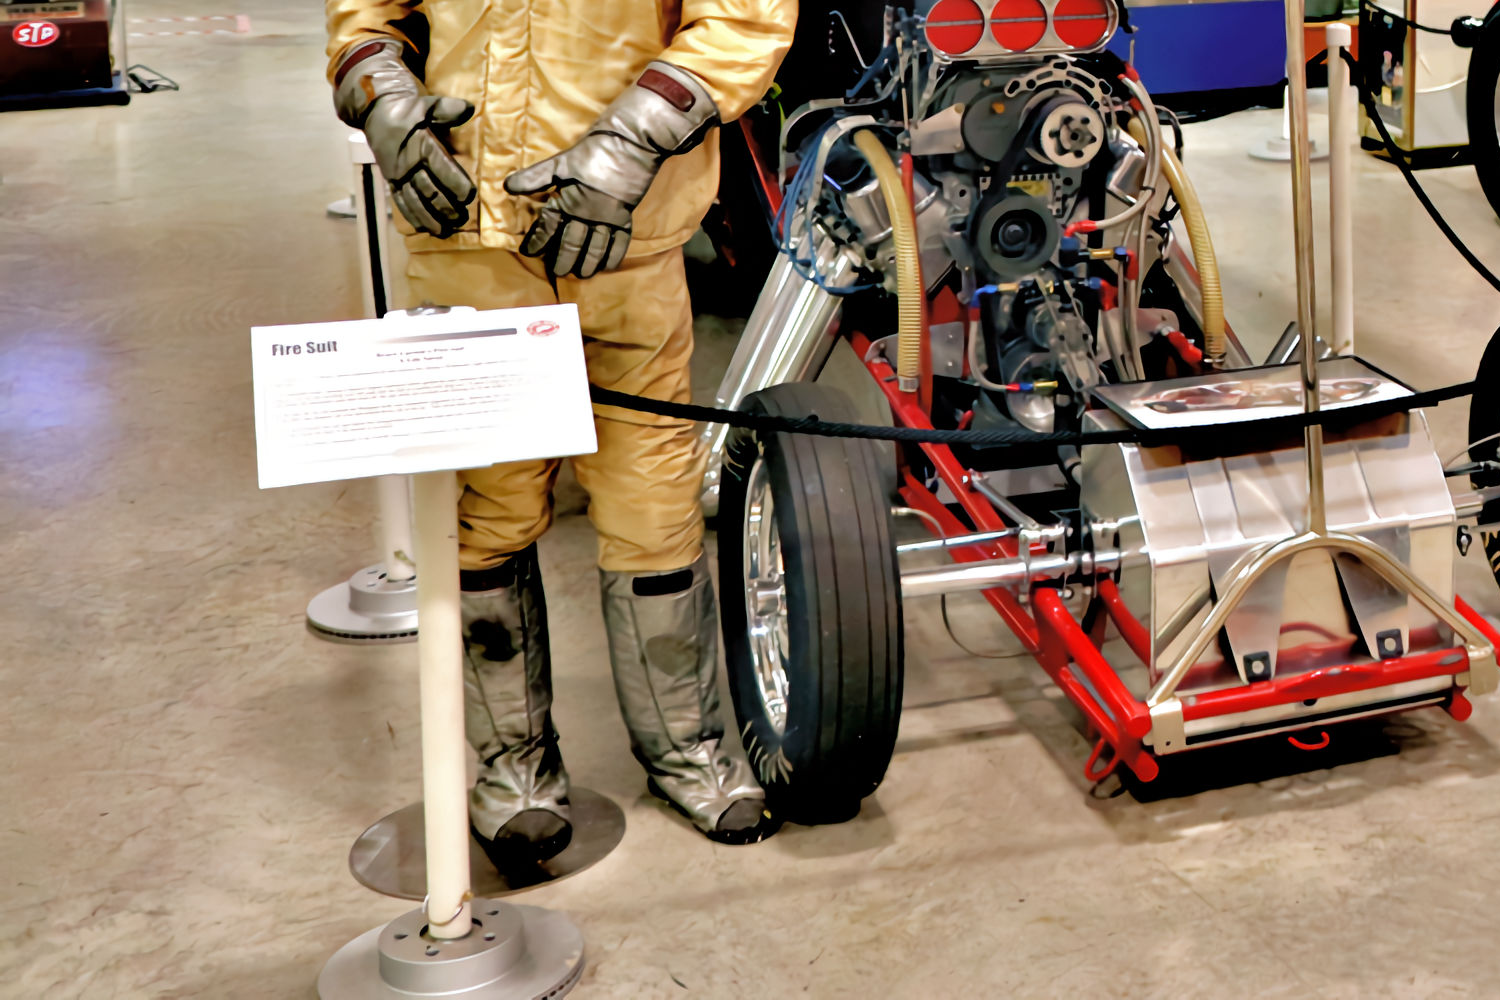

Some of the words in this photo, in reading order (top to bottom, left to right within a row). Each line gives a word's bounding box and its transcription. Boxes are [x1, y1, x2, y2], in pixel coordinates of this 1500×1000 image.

[17, 22, 54, 43] STP
[272, 343, 301, 356] Fire
[306, 341, 338, 354] Suit
